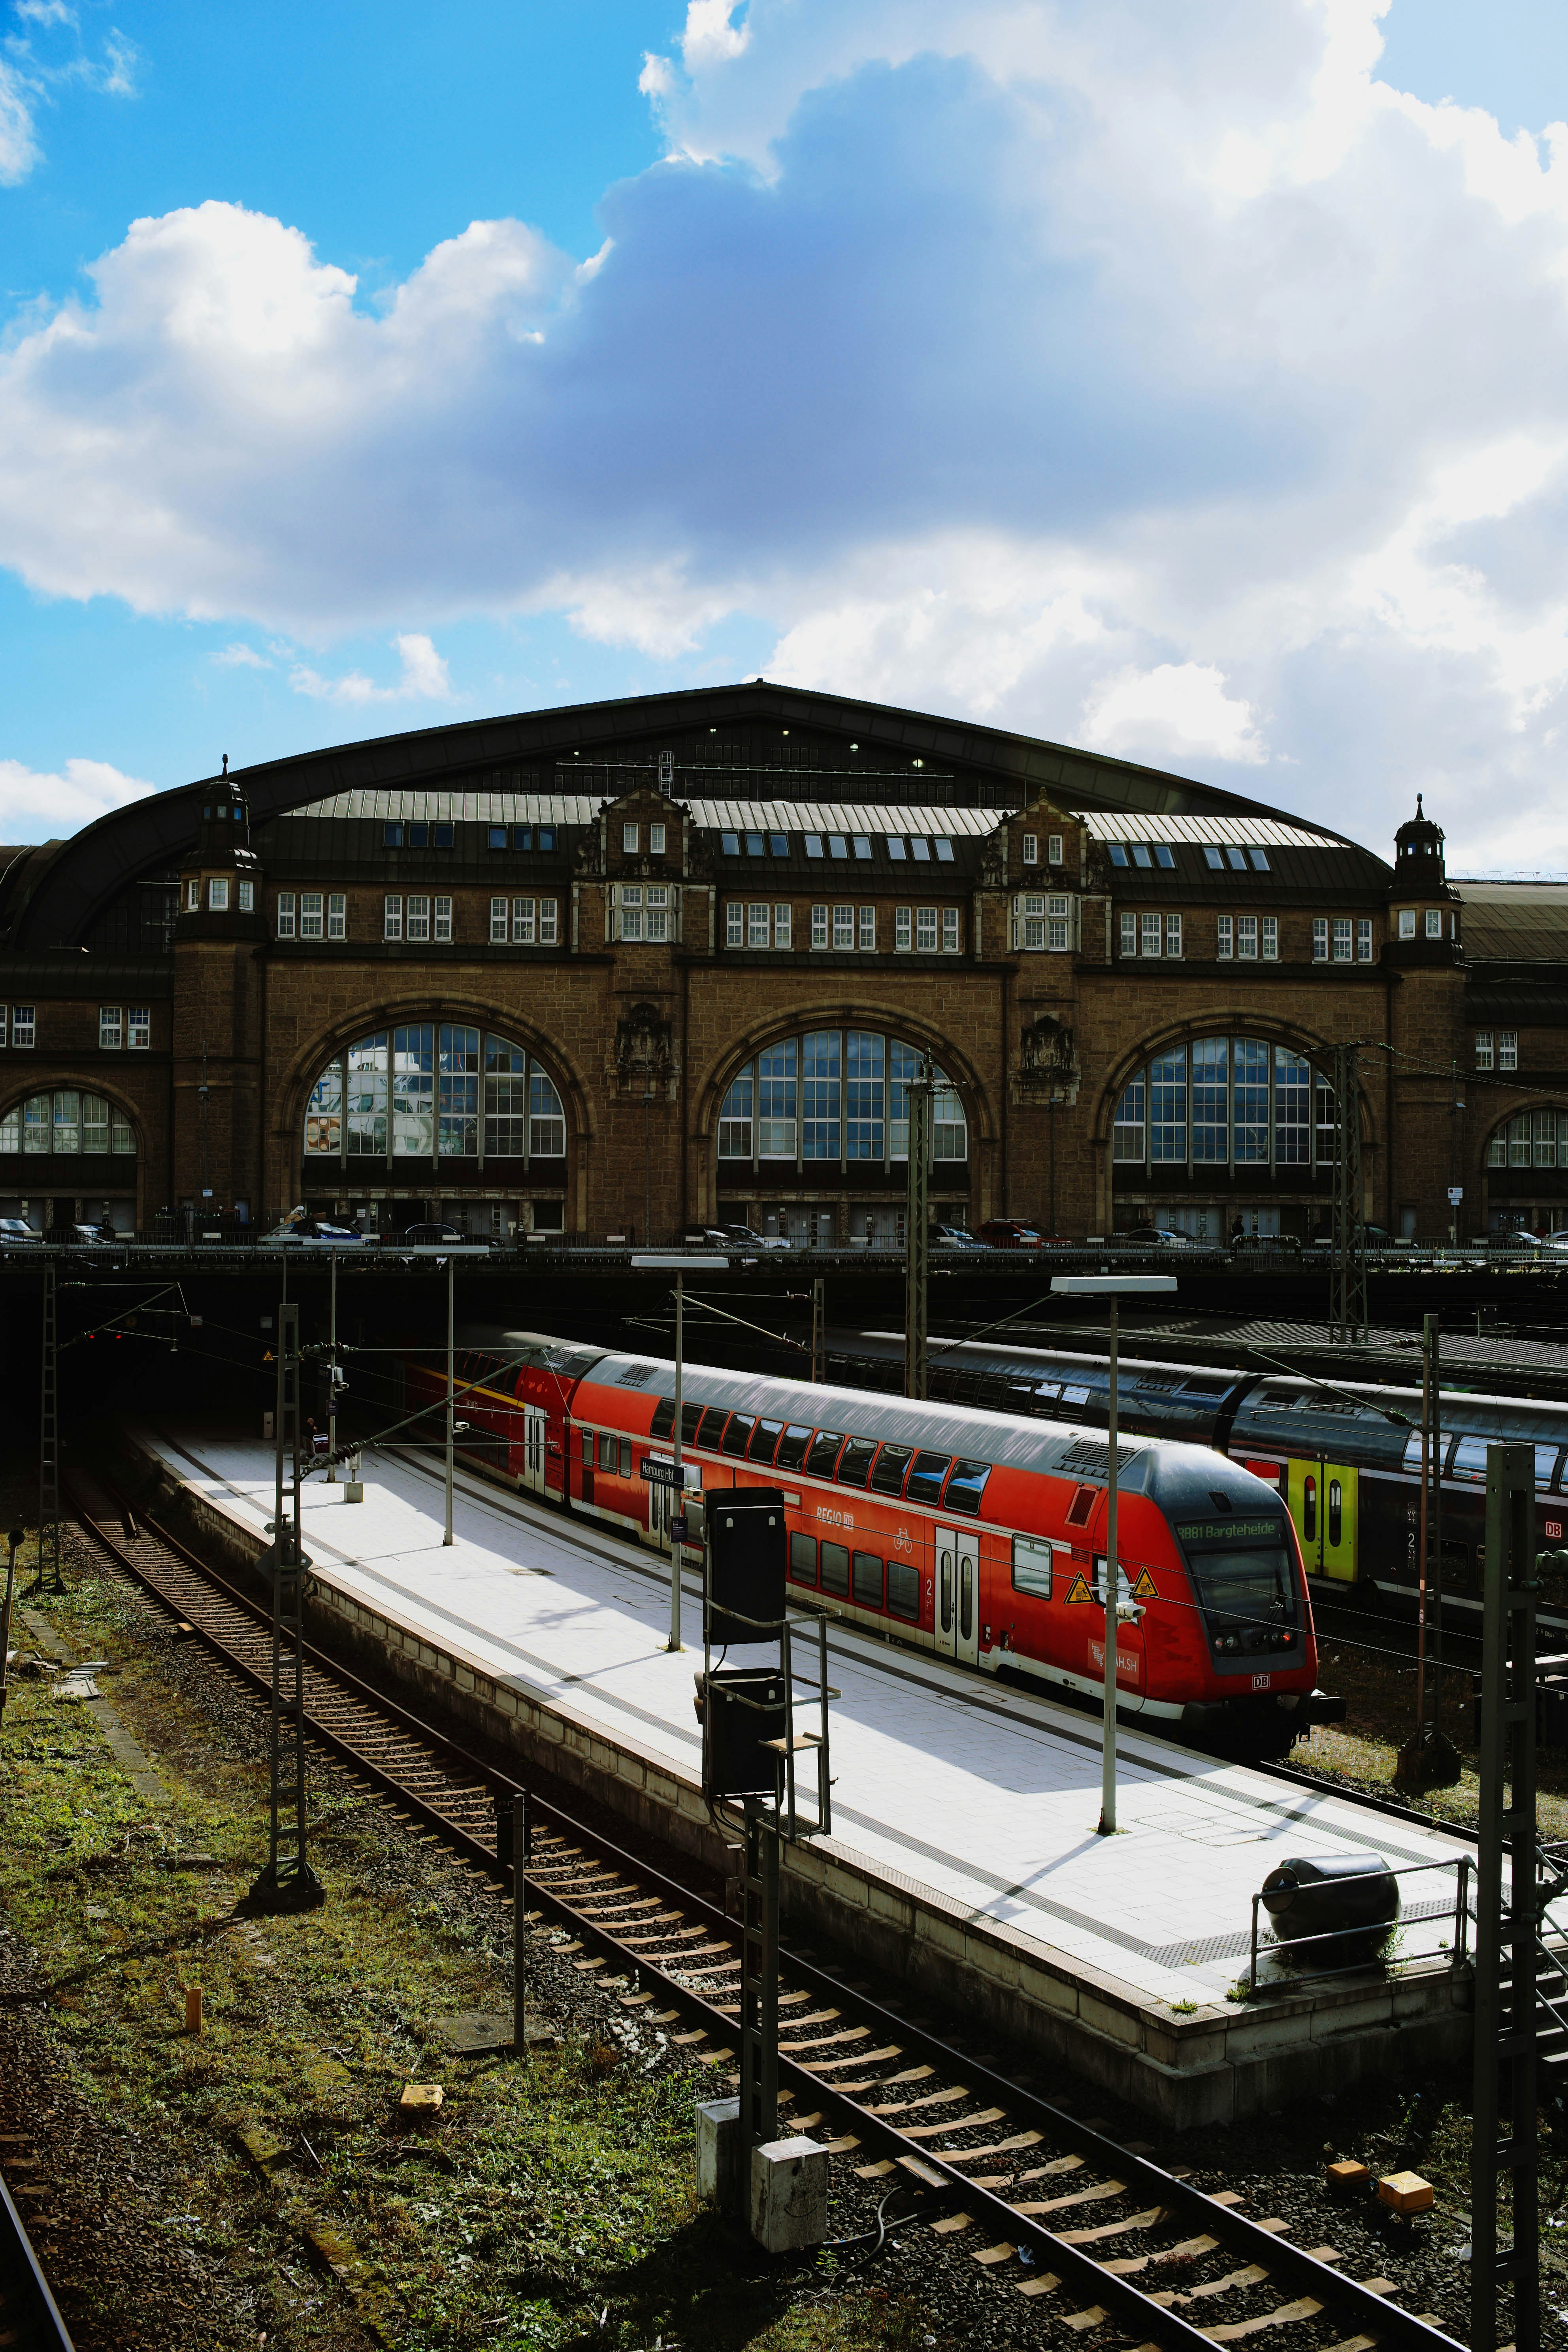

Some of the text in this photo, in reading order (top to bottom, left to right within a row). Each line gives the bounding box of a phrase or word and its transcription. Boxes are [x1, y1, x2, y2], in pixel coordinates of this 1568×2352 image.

[643, 1461, 674, 1481] Hamburg Hbf
[816, 1506, 853, 1530] REGIO DB
[1178, 1523, 1275, 1540] RB81 Bargteheide
[1547, 1523, 1561, 1537] DB
[1408, 1533, 1415, 1548] 2
[926, 1579, 933, 1596] 2
[1116, 1656, 1136, 1672] AH.SH
[1254, 1675, 1268, 1688] DB
